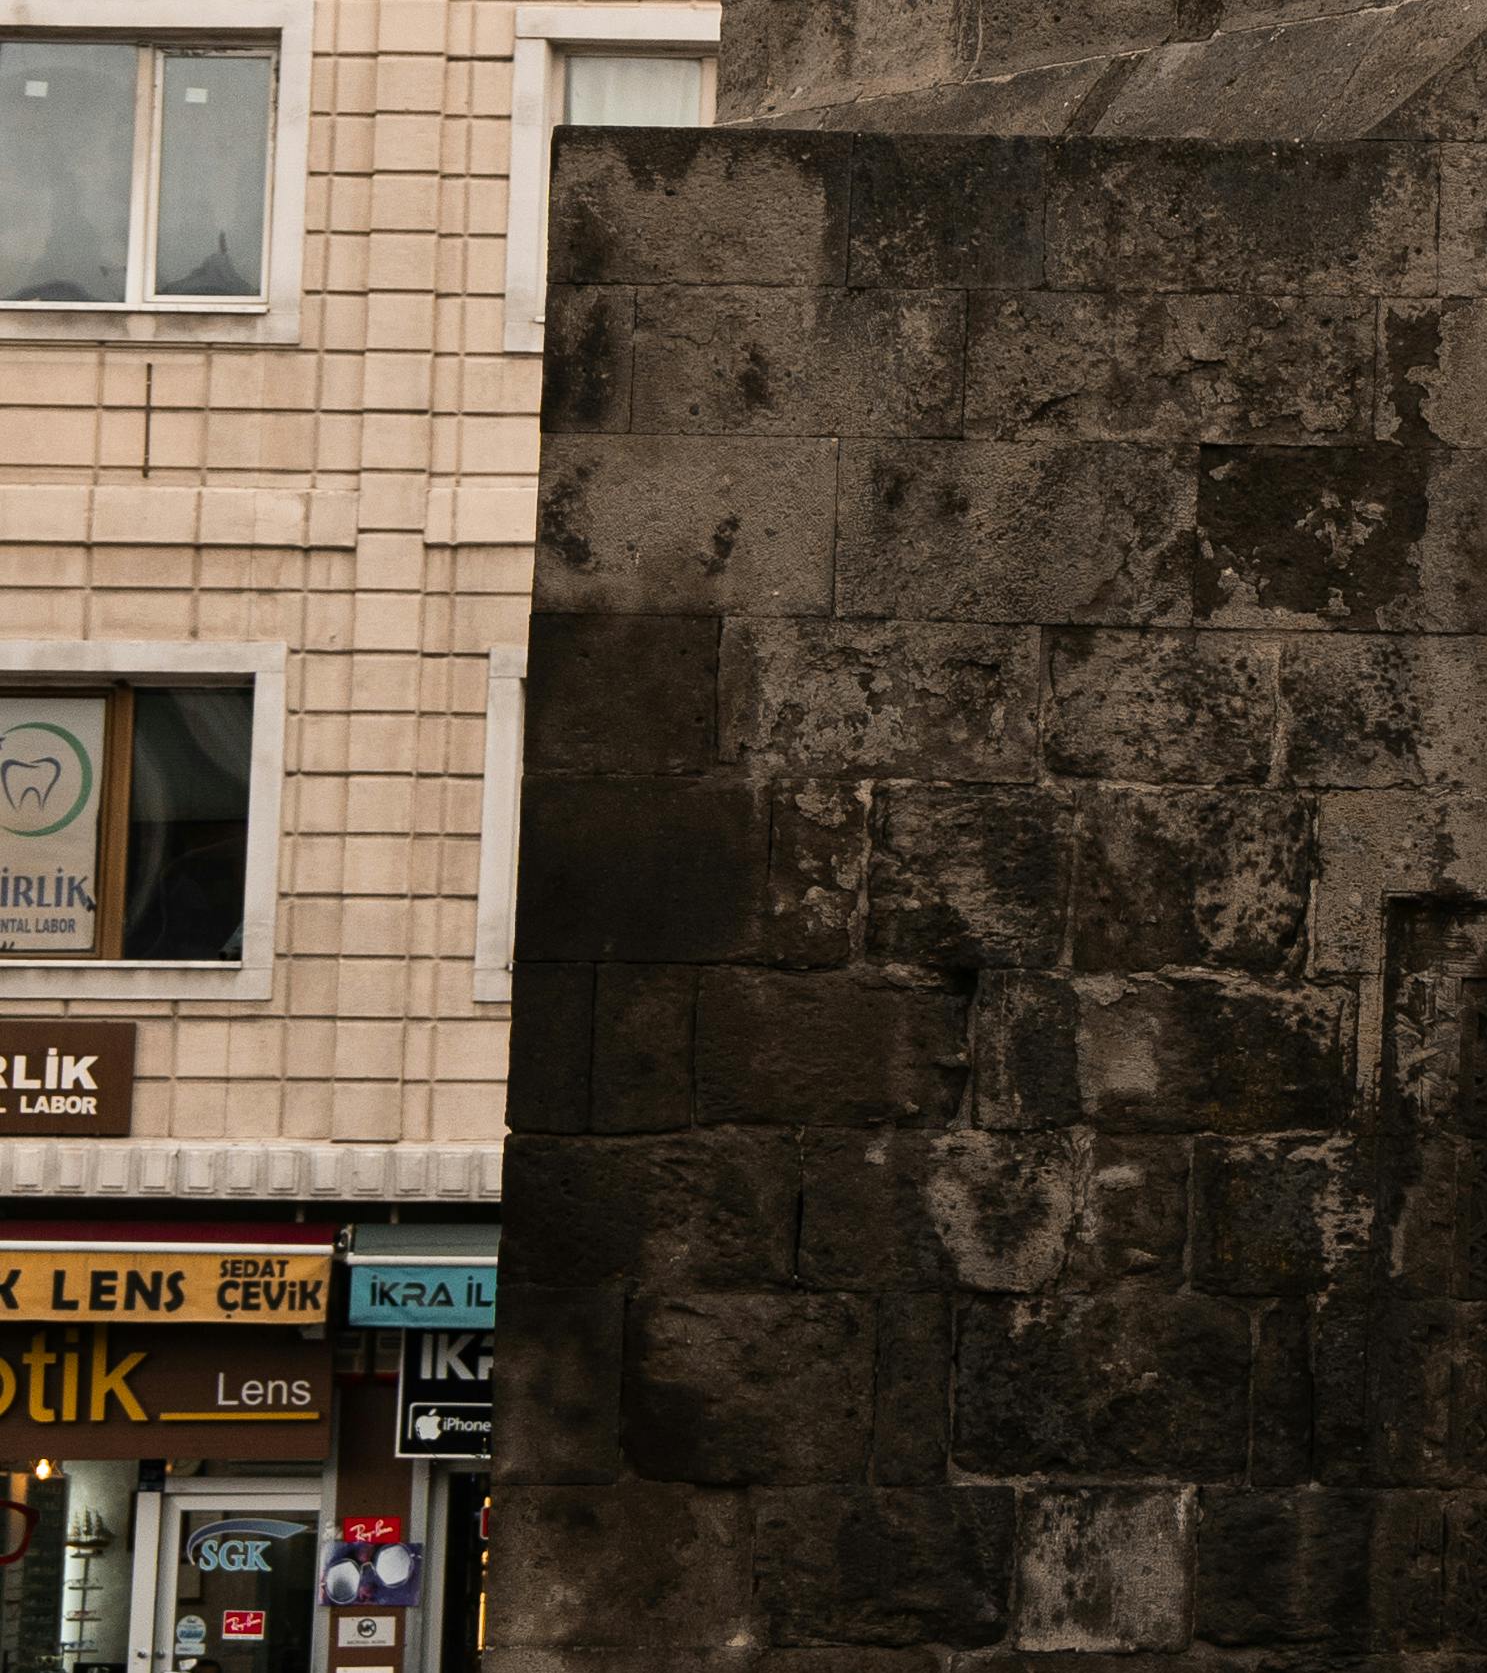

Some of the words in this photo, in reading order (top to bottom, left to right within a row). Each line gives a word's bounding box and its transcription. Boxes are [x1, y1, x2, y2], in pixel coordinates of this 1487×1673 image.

[35, 918, 76, 934] LABOR
[20, 1095, 97, 1115] LABOR
[220, 1259, 289, 1279] SEDAT
[52, 1269, 186, 1312] LENS
[370, 1275, 455, 1307] İKRA
[217, 1372, 311, 1405] Lens
[443, 1416, 492, 1433] iPhone
[199, 1539, 272, 1572] SGK
